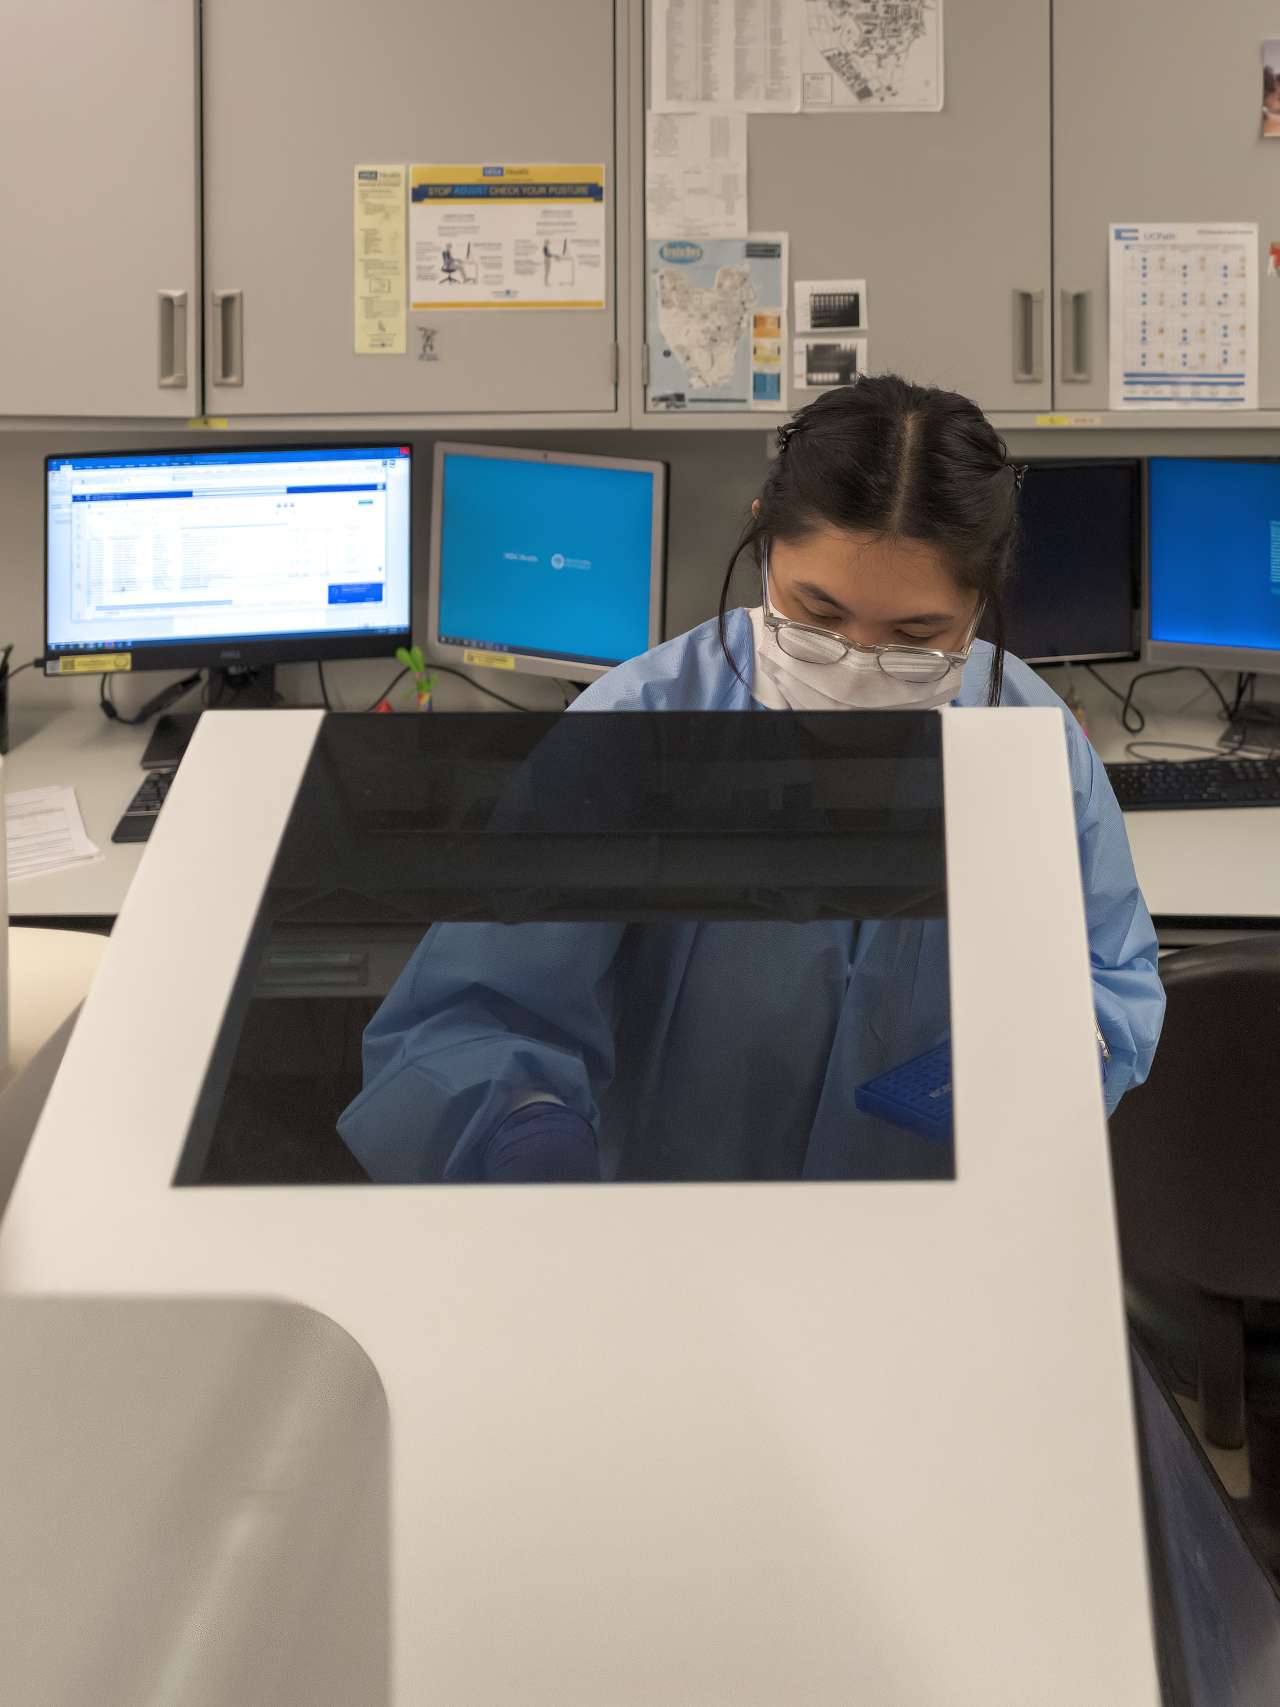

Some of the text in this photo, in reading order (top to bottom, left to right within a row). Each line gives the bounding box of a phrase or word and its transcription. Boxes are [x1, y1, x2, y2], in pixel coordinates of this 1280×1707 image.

[428, 186, 450, 195] STOP
[490, 186, 520, 196] CHECK
[522, 186, 547, 195] YOUR
[549, 186, 589, 195] POSTURE
